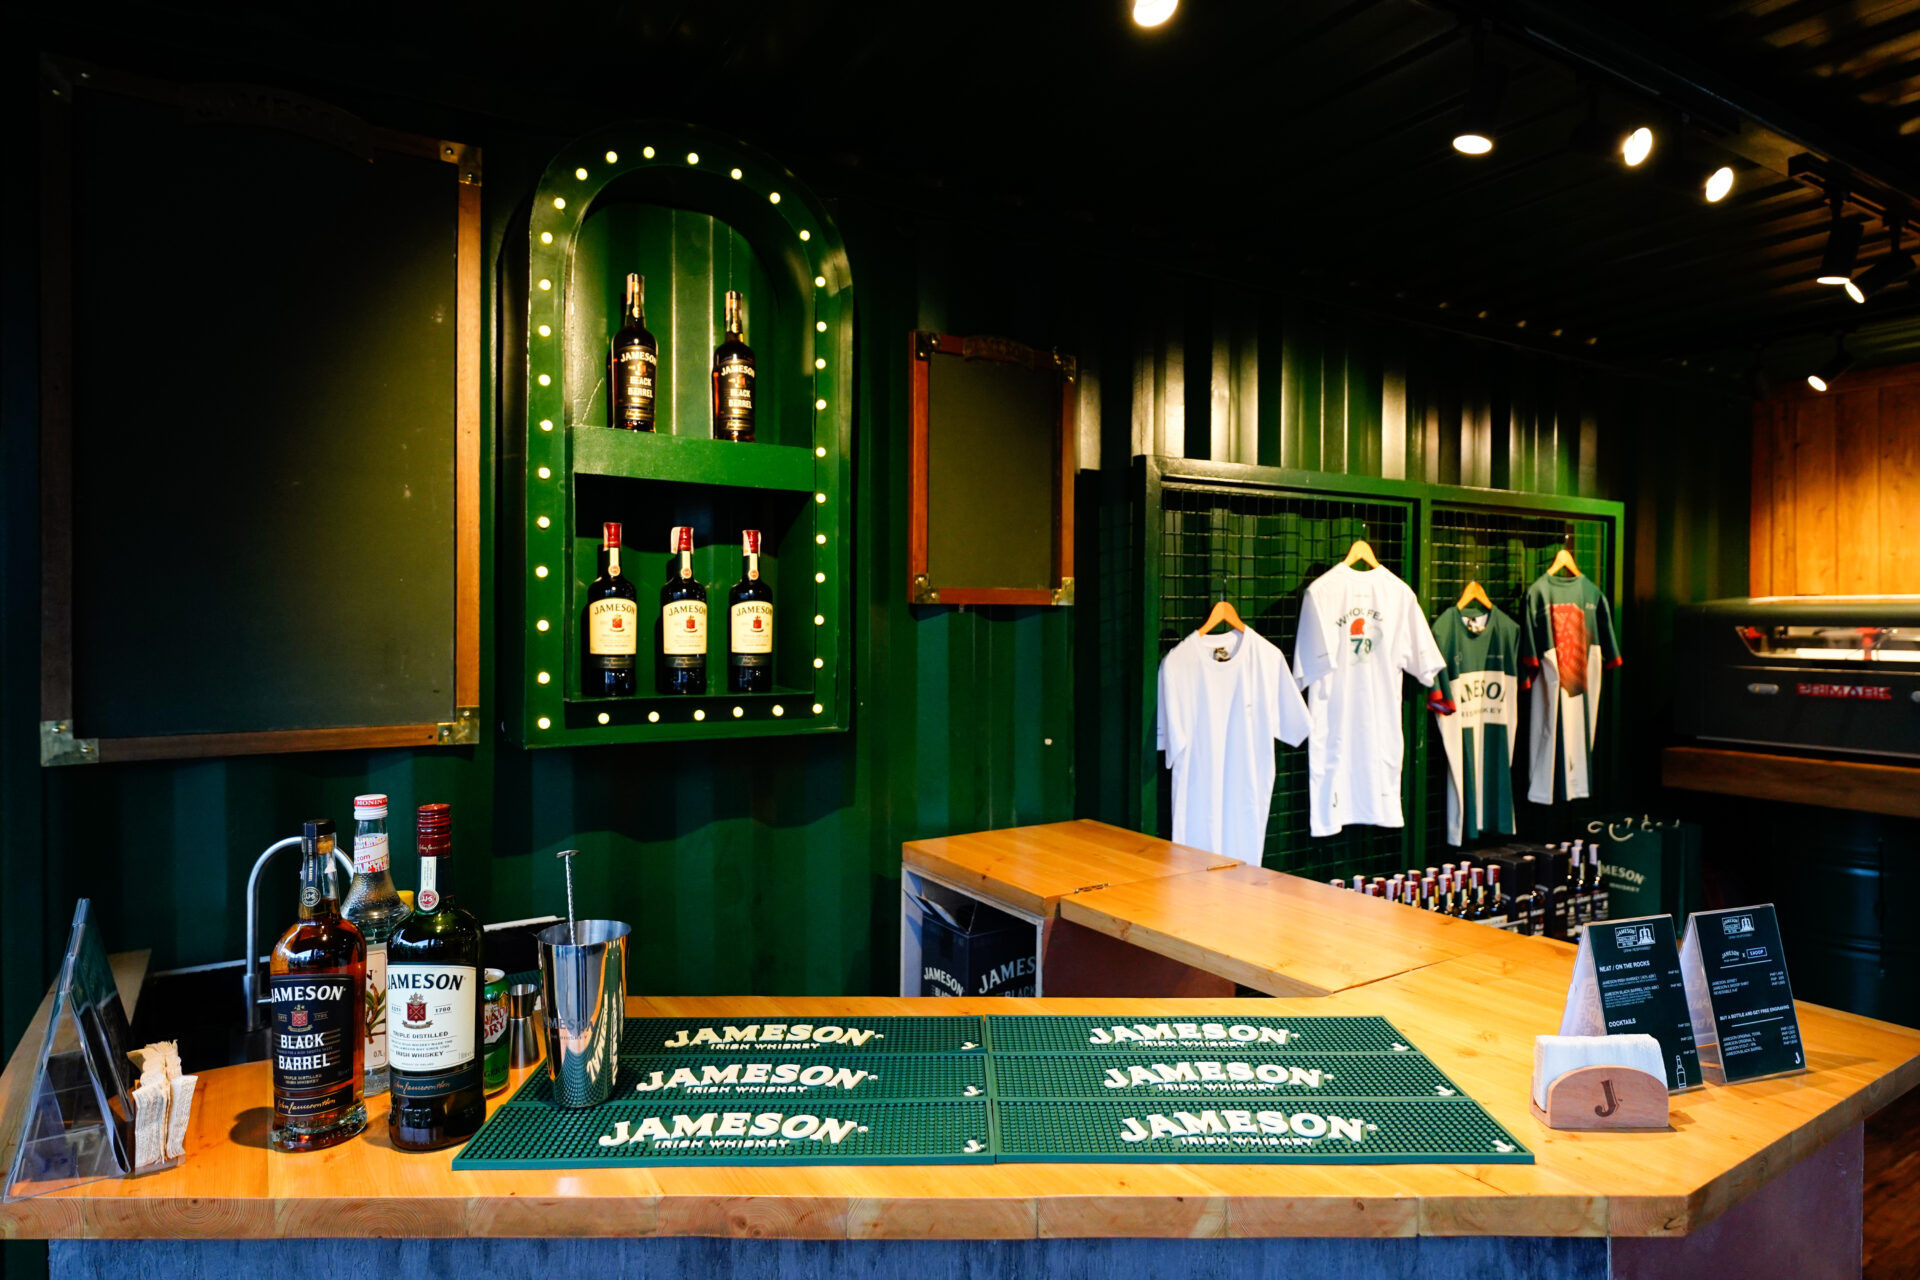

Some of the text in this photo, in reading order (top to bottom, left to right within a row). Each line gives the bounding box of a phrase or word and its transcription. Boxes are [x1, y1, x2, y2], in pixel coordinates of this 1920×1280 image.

[620, 351, 656, 367] JAMESON
[721, 364, 756, 378] JAMESON
[594, 603, 635, 616] JAMESON
[668, 604, 707, 617] JAMESON
[736, 605, 773, 617] JAMESON
[1722, 950, 1740, 959] JAMESON
[1633, 960, 1650, 968] ROCKS
[388, 973, 464, 991] JAMESON
[924, 966, 964, 997] JAMESON
[979, 956, 1036, 995] JAMES
[271, 985, 344, 1003] JAMESON
[1609, 1018, 1636, 1027] COCKTAILS
[280, 1032, 325, 1049] BLACK
[393, 1030, 449, 1039] TRIPLE DISTILLED
[664, 1024, 875, 1047] JAMESON
[1089, 1023, 1290, 1045] JAMESON
[278, 1053, 331, 1070] BARREL
[395, 1050, 444, 1058] IRISH WHISKEY
[1795, 1052, 1801, 1064] J
[636, 1064, 869, 1092] JAMESON
[1104, 1061, 1322, 1088] JAMESON
[686, 1086, 731, 1094] IRISH
[1157, 1083, 1276, 1091] IRISH WHISKEY
[1594, 1079, 1620, 1118] J
[598, 1112, 858, 1147] JAMESON
[1120, 1110, 1364, 1142] JAMESON
[654, 1139, 791, 1149] IRISH WHISKEY
[1180, 1136, 1313, 1146] IRISH WHISKEY
